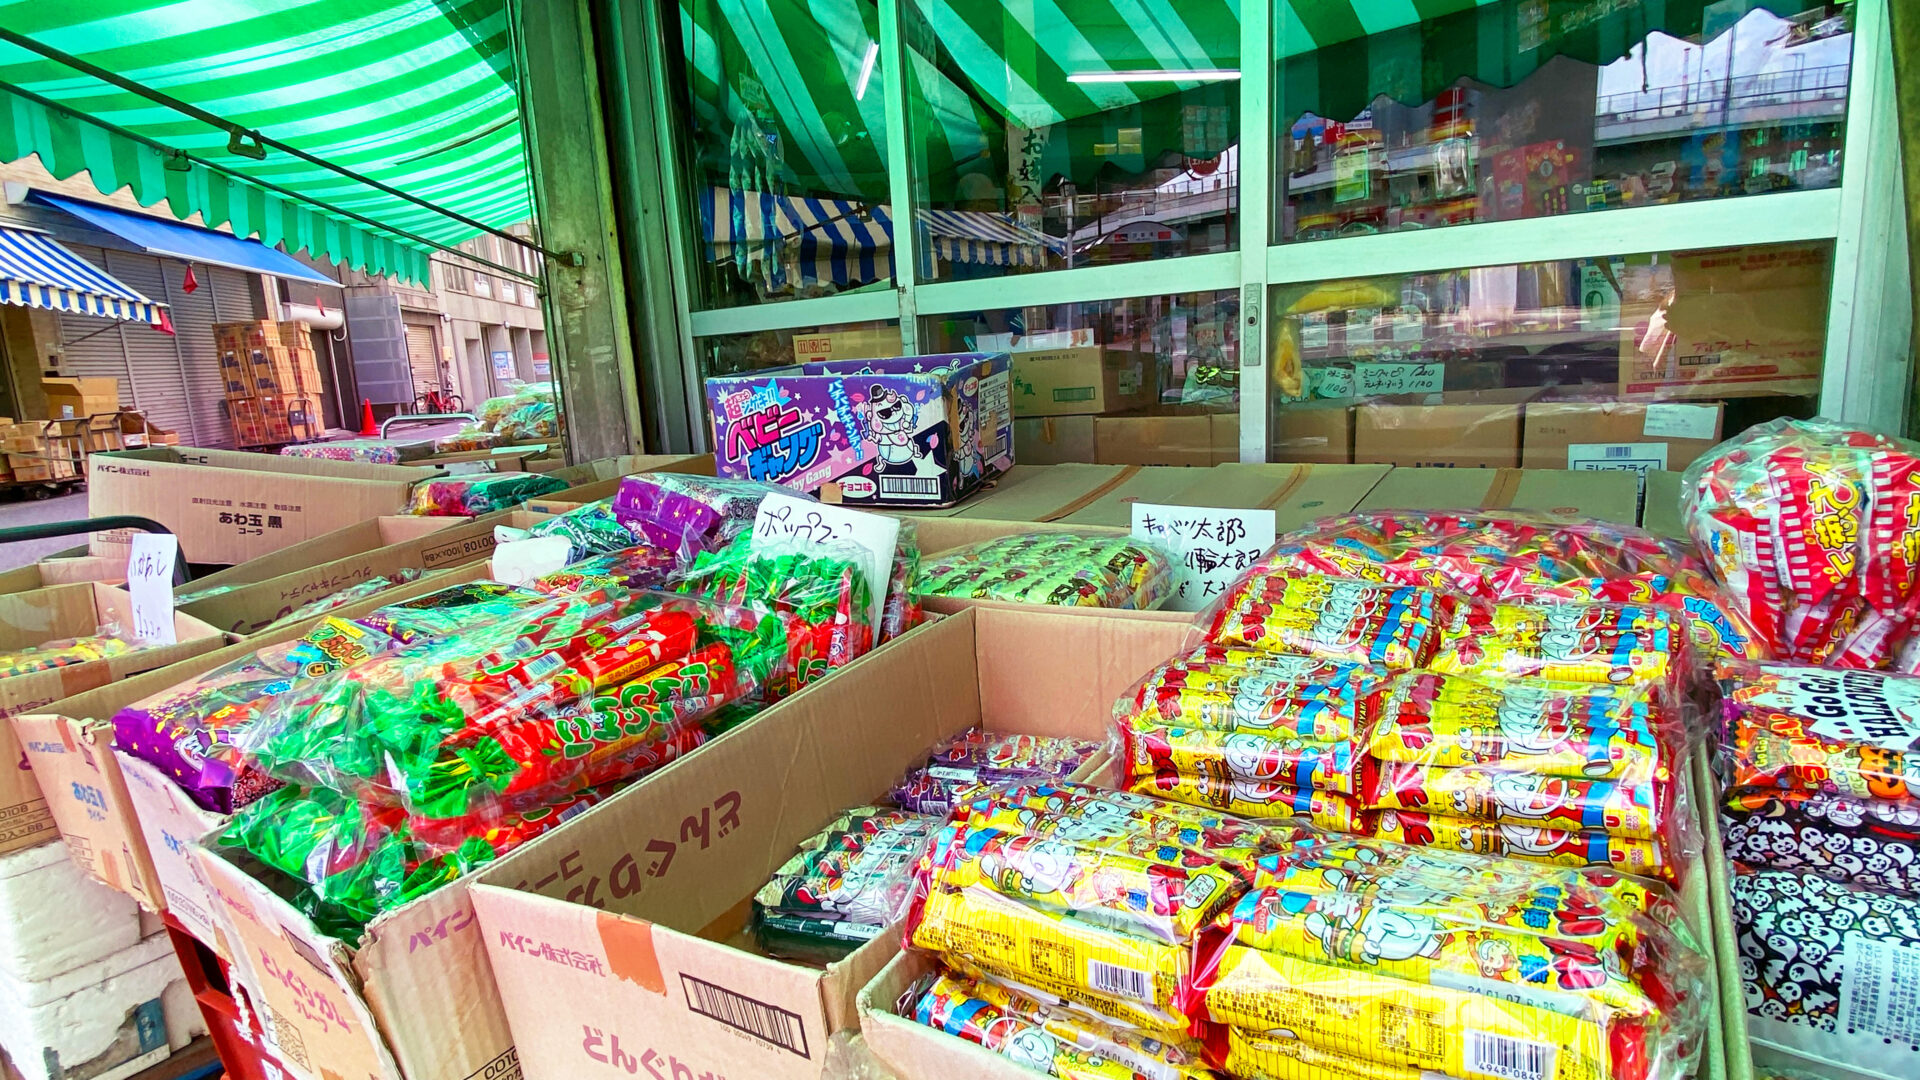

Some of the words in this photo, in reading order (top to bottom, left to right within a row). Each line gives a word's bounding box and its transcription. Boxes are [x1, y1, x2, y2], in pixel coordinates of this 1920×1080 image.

[728, 404, 801, 461] ベビー
[748, 421, 824, 482] ギャング
[806, 466, 832, 485] Gang
[838, 480, 873, 494] チョコ味
[219, 511, 263, 527] あわ玉
[268, 515, 283, 529] 黒
[238, 527, 263, 536] コーラ
[1142, 513, 1246, 546] キャベツ太郎
[280, 566, 373, 600] グレープキャンディ
[1842, 670, 1910, 738] HALLOWEEN
[499, 930, 608, 977] パイン株式会社
[1477, 1061, 1510, 1078] 4948
